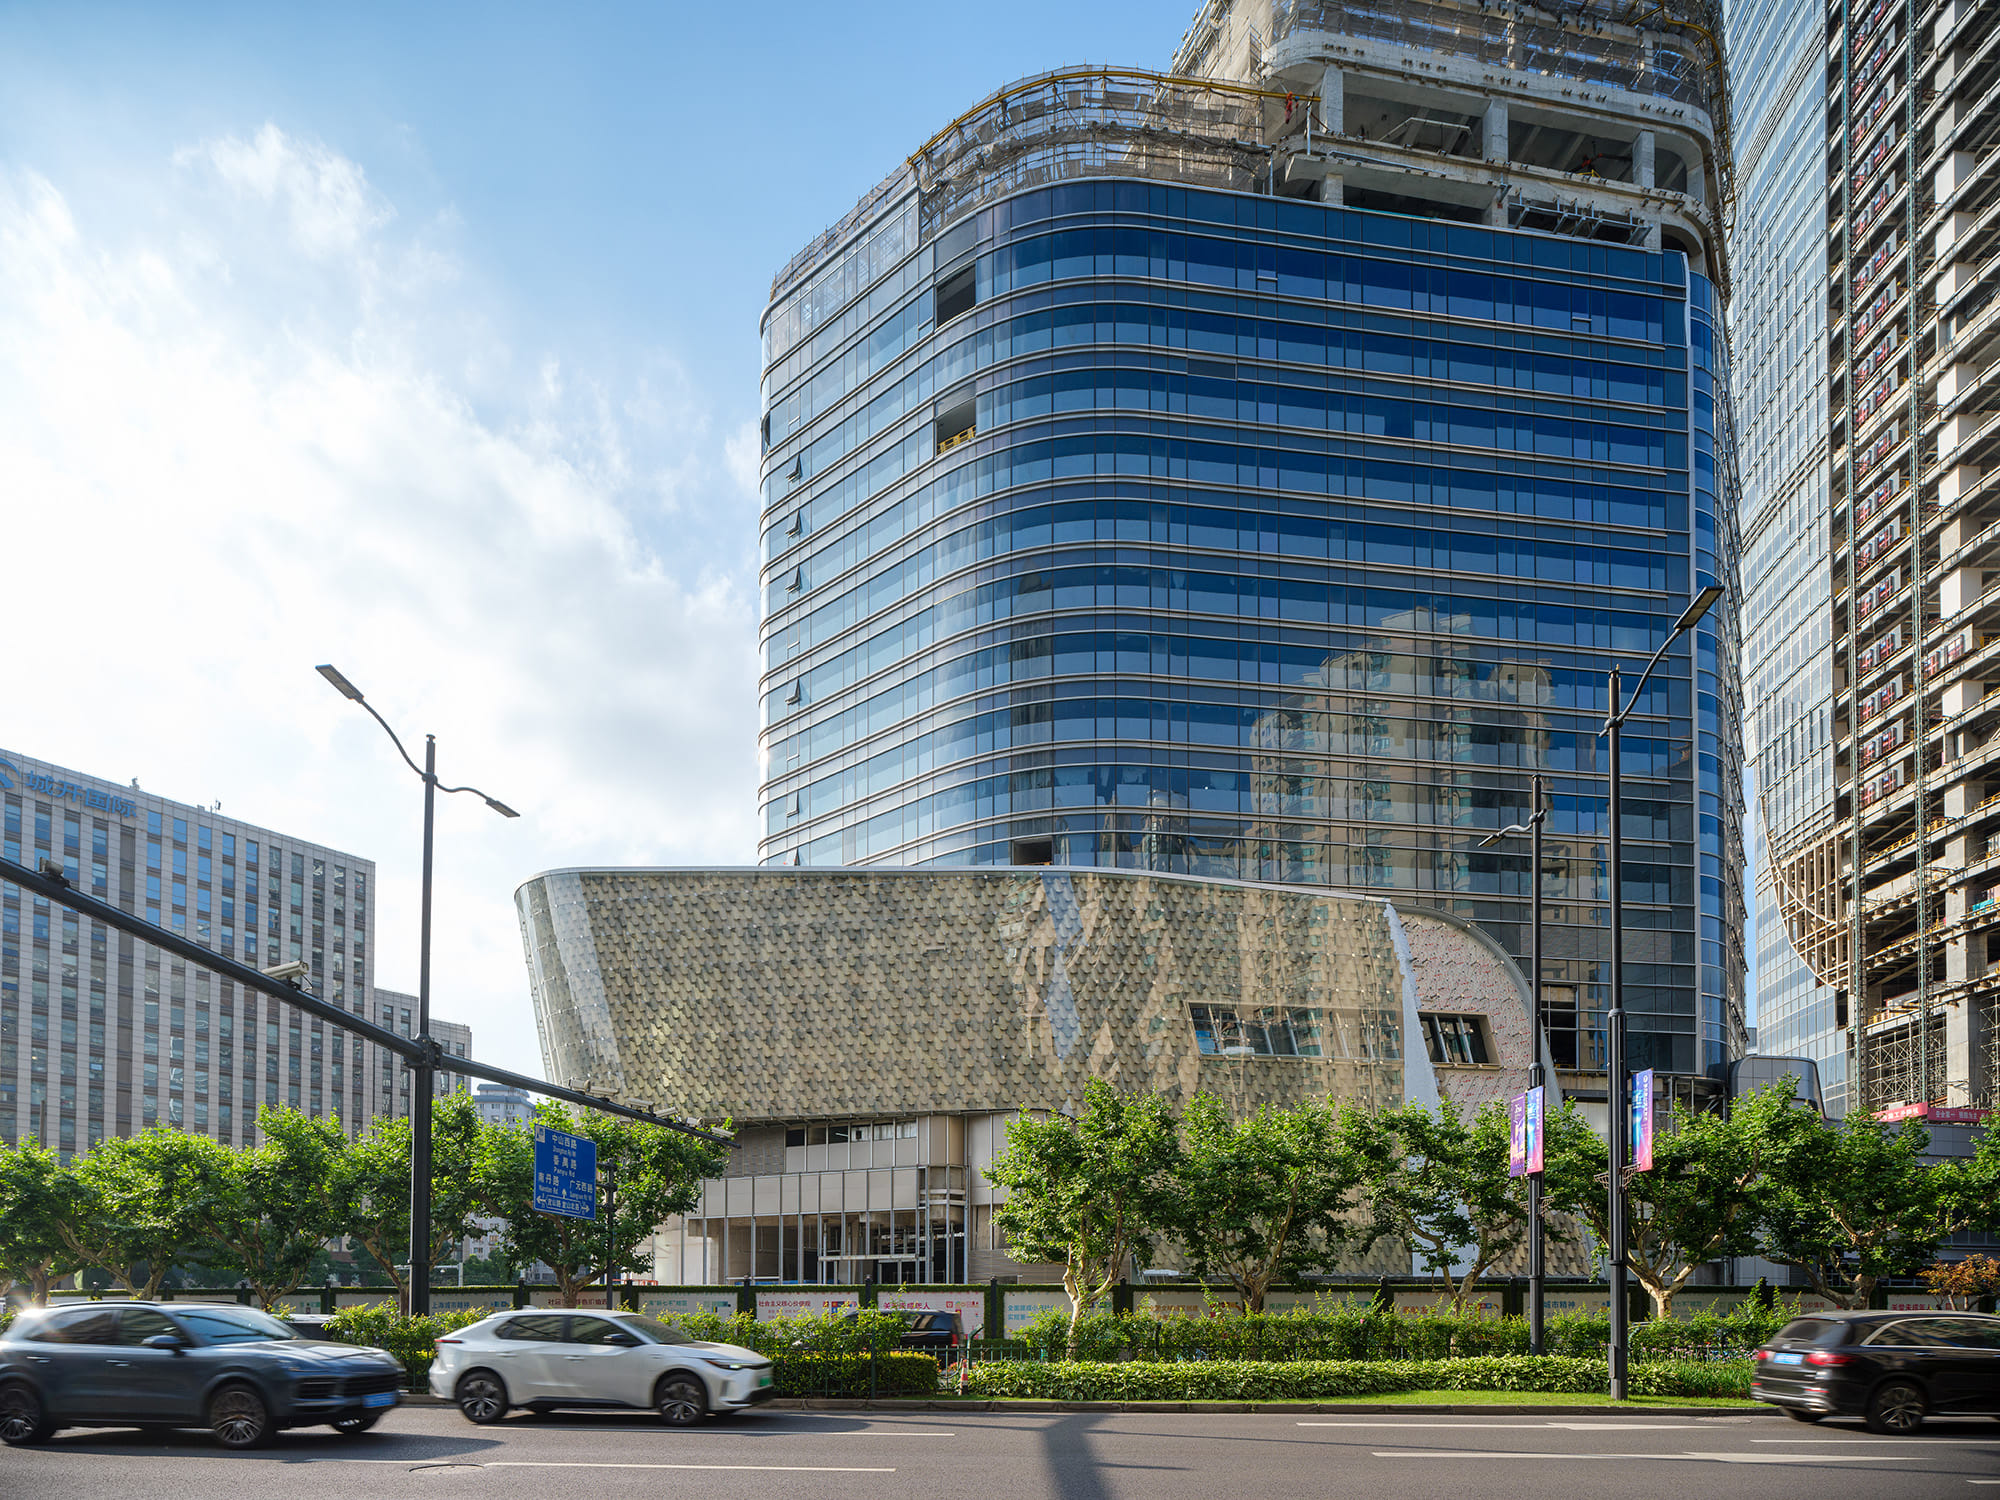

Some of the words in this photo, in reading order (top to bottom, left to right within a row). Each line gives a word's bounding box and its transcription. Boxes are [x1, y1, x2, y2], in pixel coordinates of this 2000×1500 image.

[25, 770, 137, 818] 城开国际
[552, 1134, 577, 1149] 中山西路
[538, 1172, 559, 1186] 南丹路
[569, 1179, 593, 1193] 广元西路
